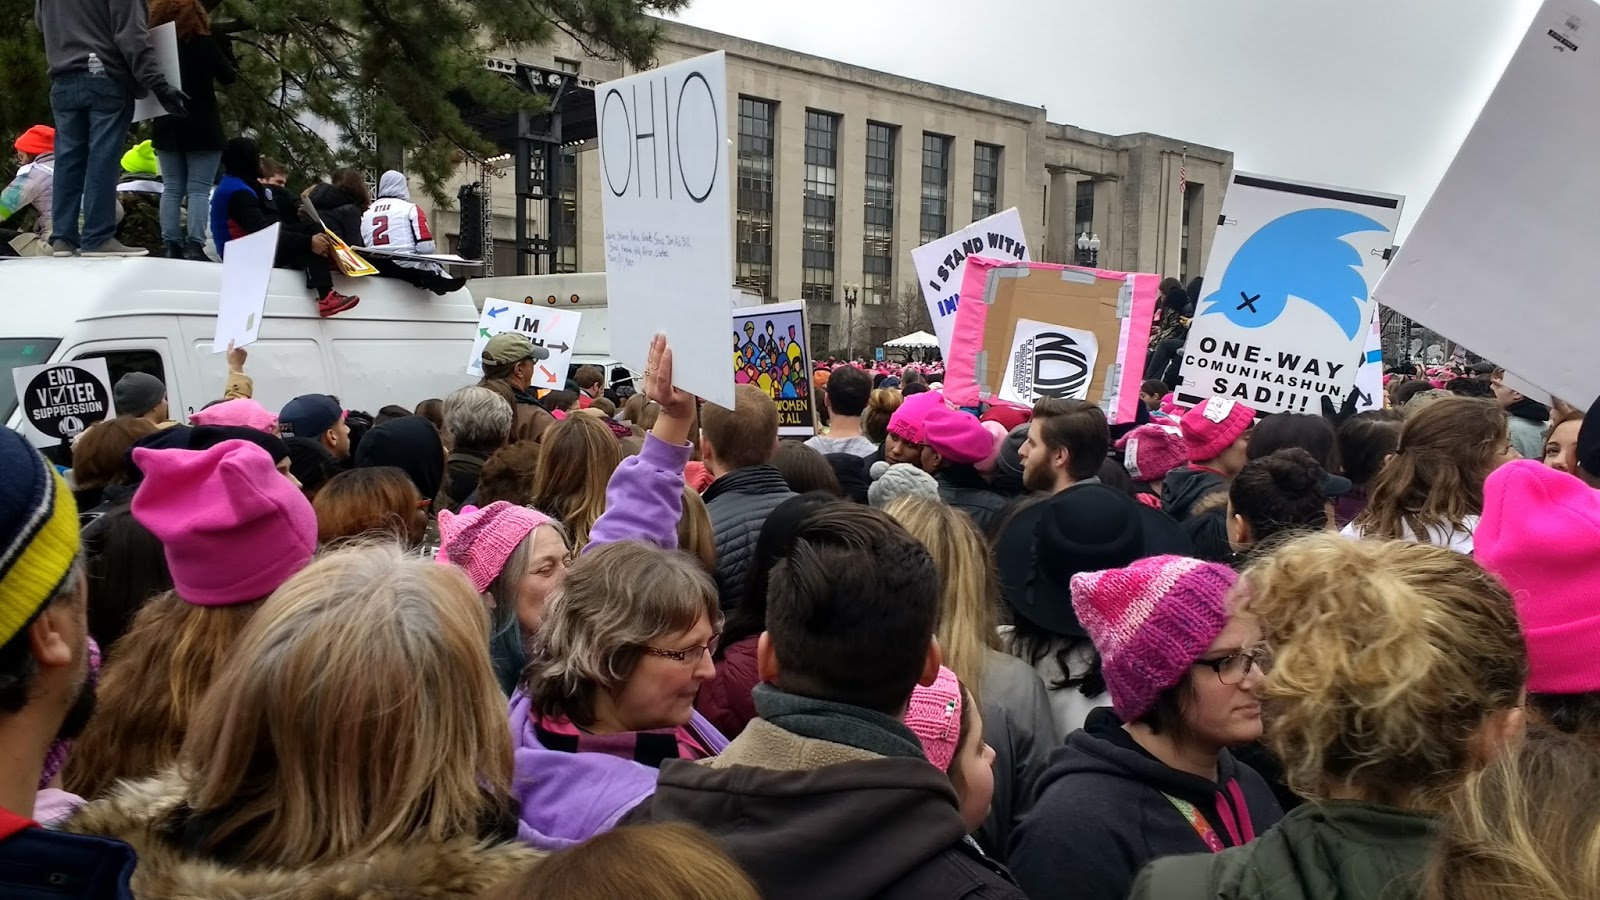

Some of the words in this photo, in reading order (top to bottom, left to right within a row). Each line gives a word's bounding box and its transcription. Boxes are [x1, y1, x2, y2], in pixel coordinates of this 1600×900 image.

[601, 71, 718, 203] OHIO
[374, 204, 391, 213] RYAN
[372, 215, 390, 246] 2
[929, 280, 942, 292] I
[937, 237, 984, 282] STAND
[987, 232, 1026, 260] WITH
[514, 314, 540, 333] I'M
[1024, 339, 1033, 399] NATIONAL
[1199, 337, 1344, 379] ONE-WAY
[47, 368, 76, 386] END
[1185, 355, 1346, 398] COMUNIKASHUN.
[775, 400, 808, 411] WOMEN
[1212, 378, 1309, 412] SAD!!!
[32, 401, 103, 420] SUPPRESSION
[786, 412, 802, 424] ALL
[892, 423, 916, 441] STRONG
